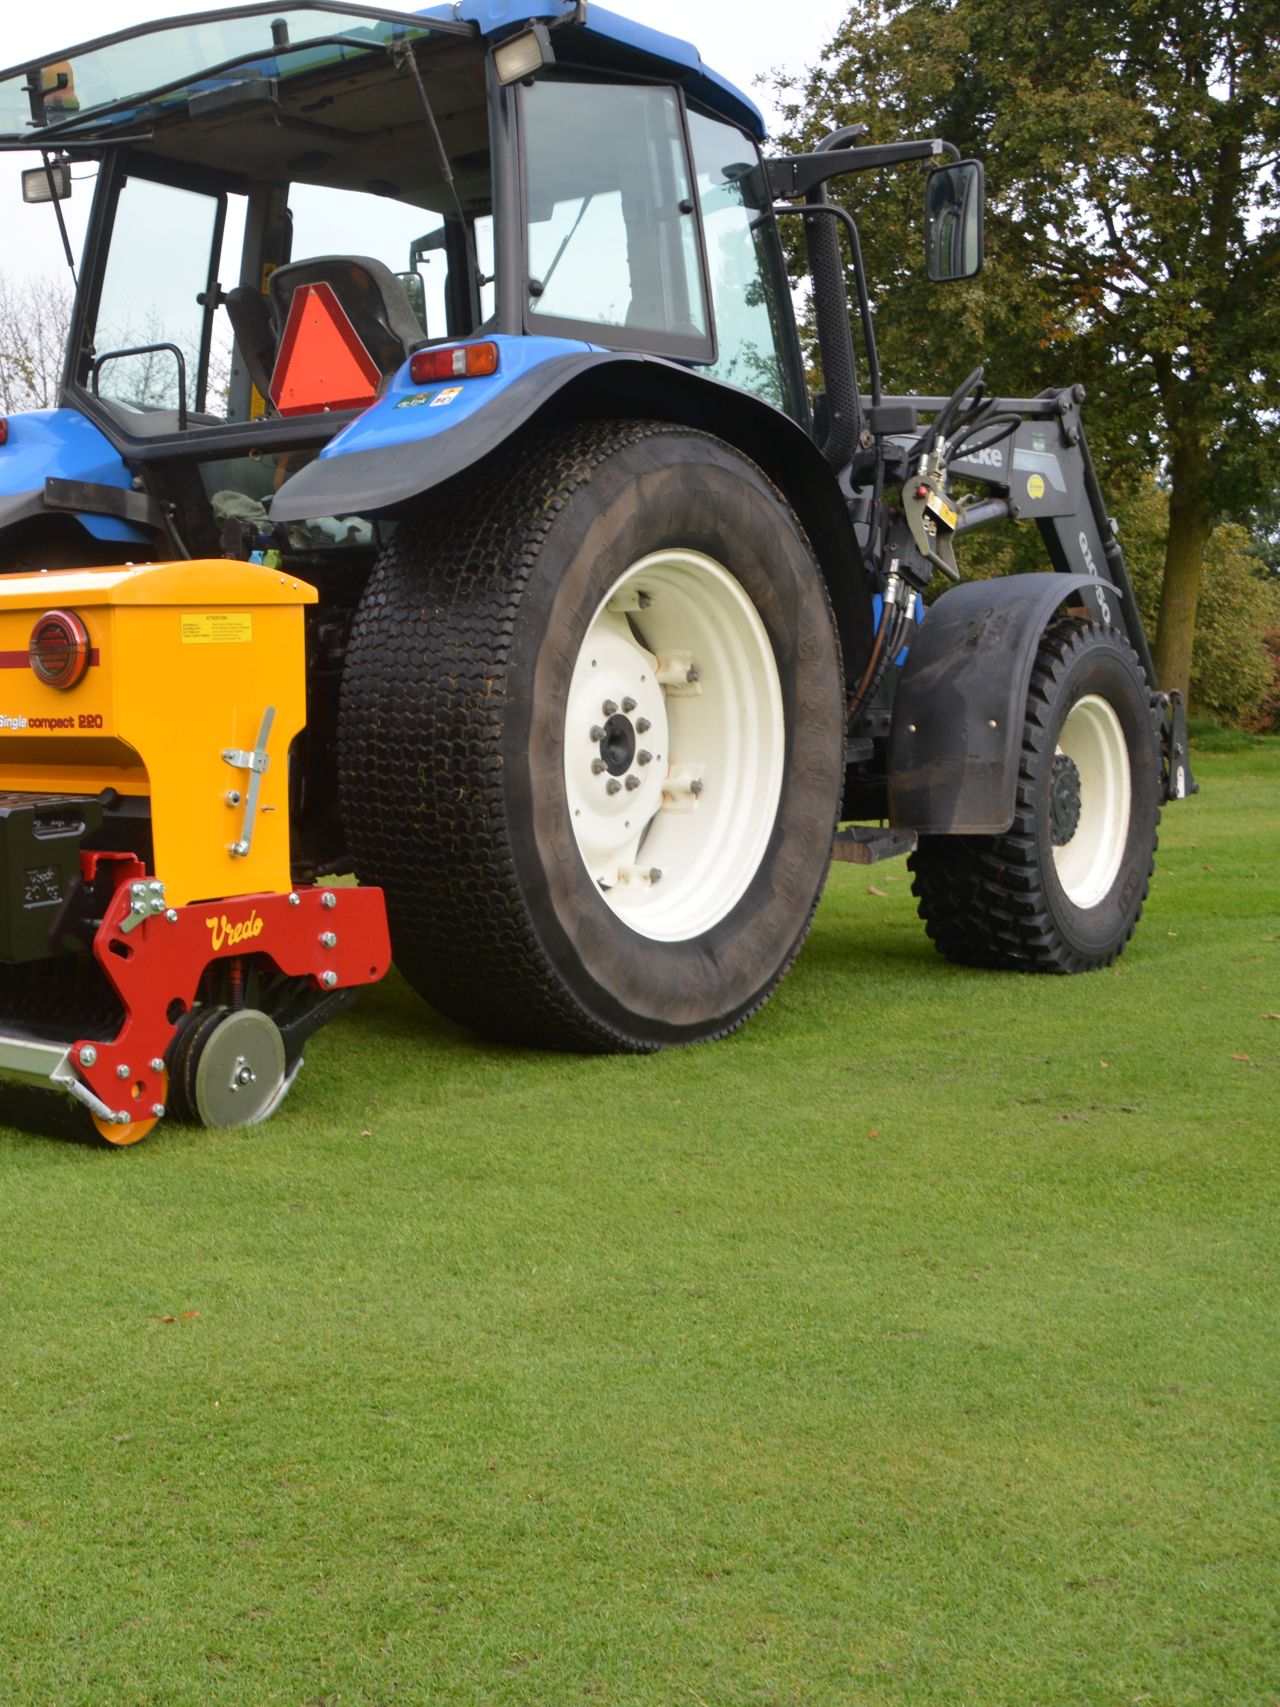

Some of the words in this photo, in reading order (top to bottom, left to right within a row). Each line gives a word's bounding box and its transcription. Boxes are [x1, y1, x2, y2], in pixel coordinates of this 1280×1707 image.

[28, 716, 75, 731] compact
[78, 714, 103, 729] 220
[206, 909, 263, 951] Vredo
